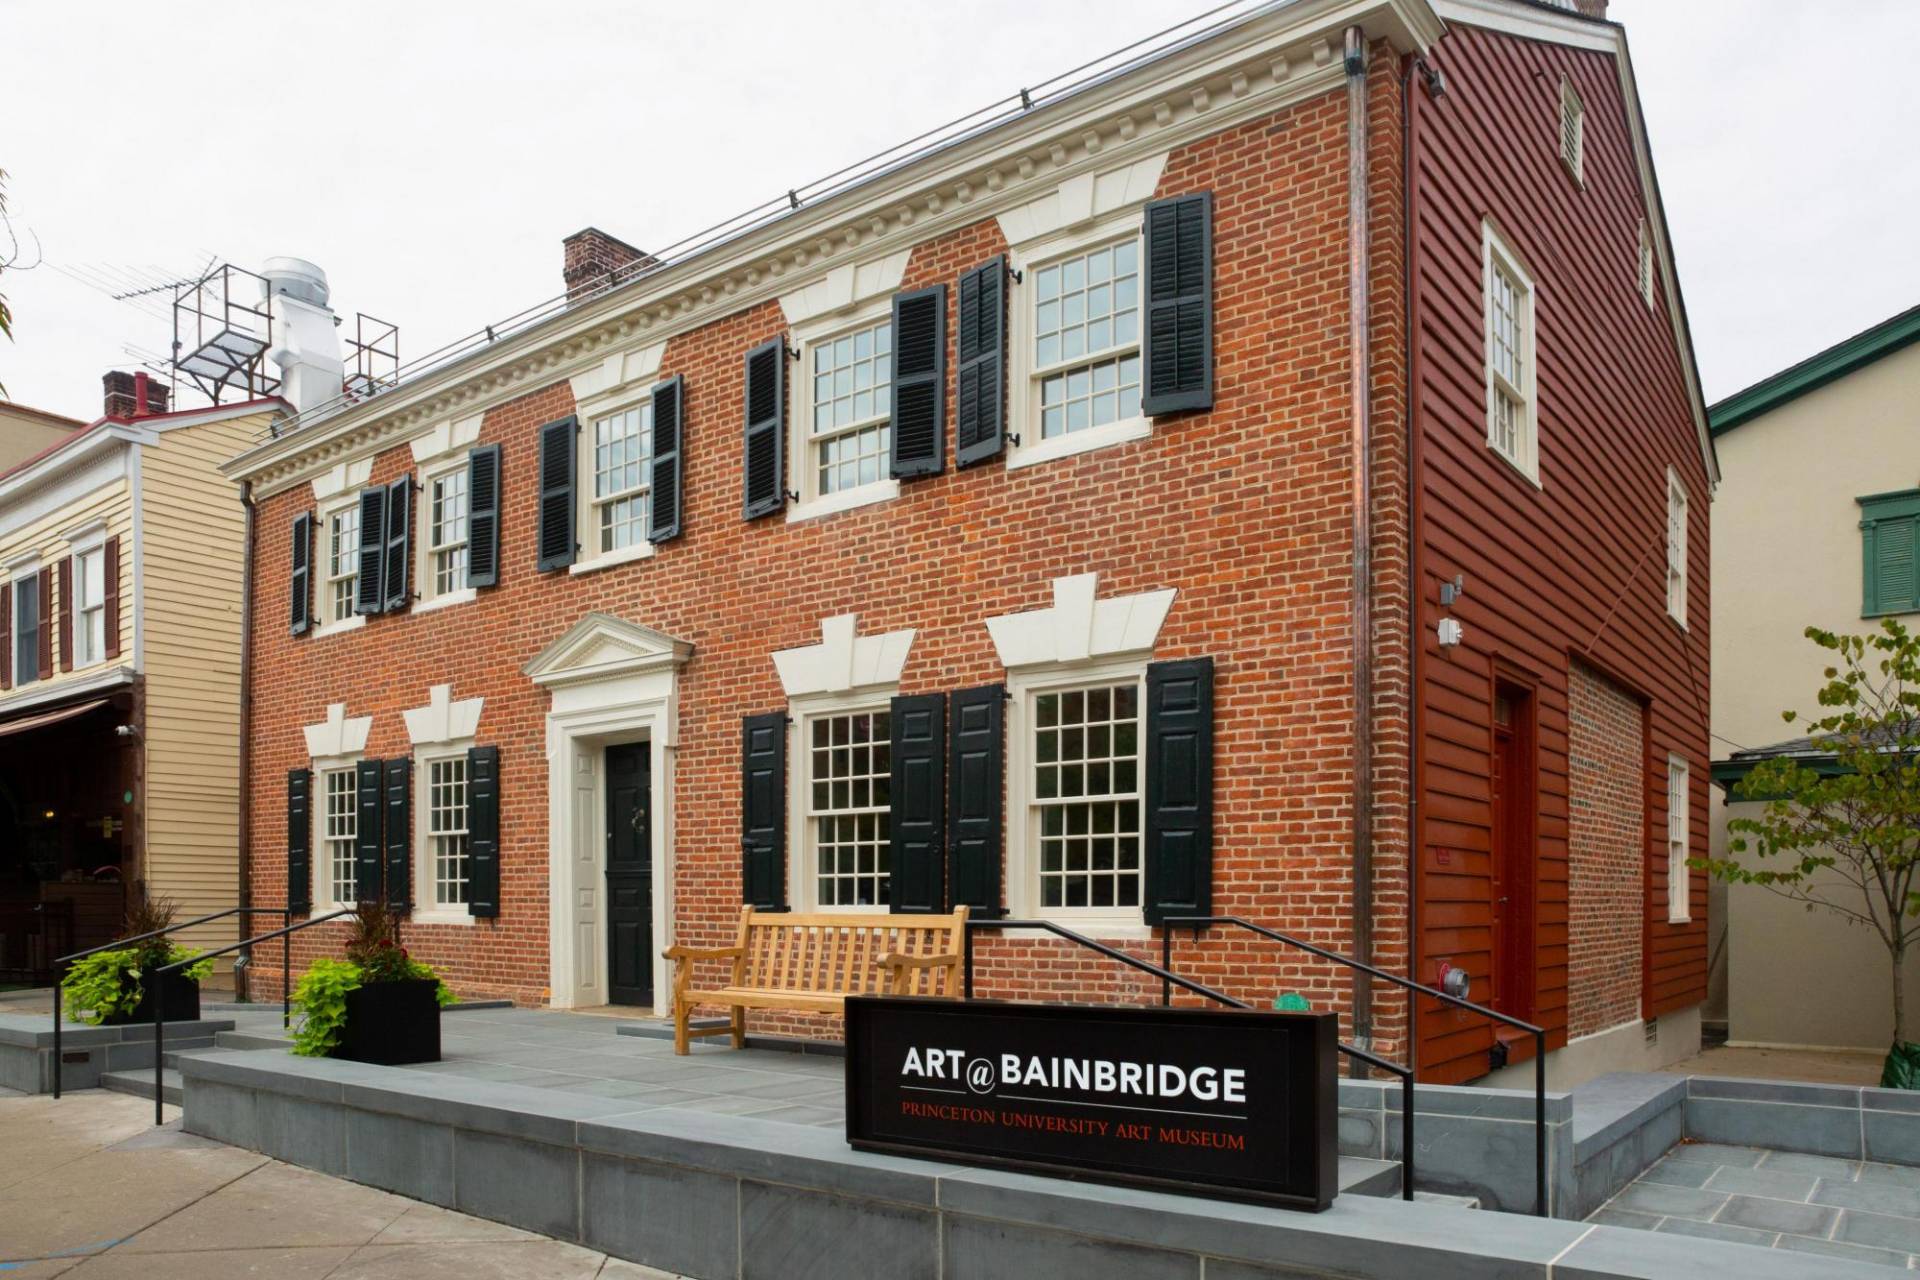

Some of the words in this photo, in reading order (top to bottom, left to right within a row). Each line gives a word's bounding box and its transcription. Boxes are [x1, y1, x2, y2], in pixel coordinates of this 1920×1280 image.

[902, 1101, 996, 1123] PRINCETON
[1001, 1112, 1109, 1136] UNIVERSITY
[1116, 1123, 1151, 1141] ART
[1159, 1128, 1245, 1151] MUSEUM
